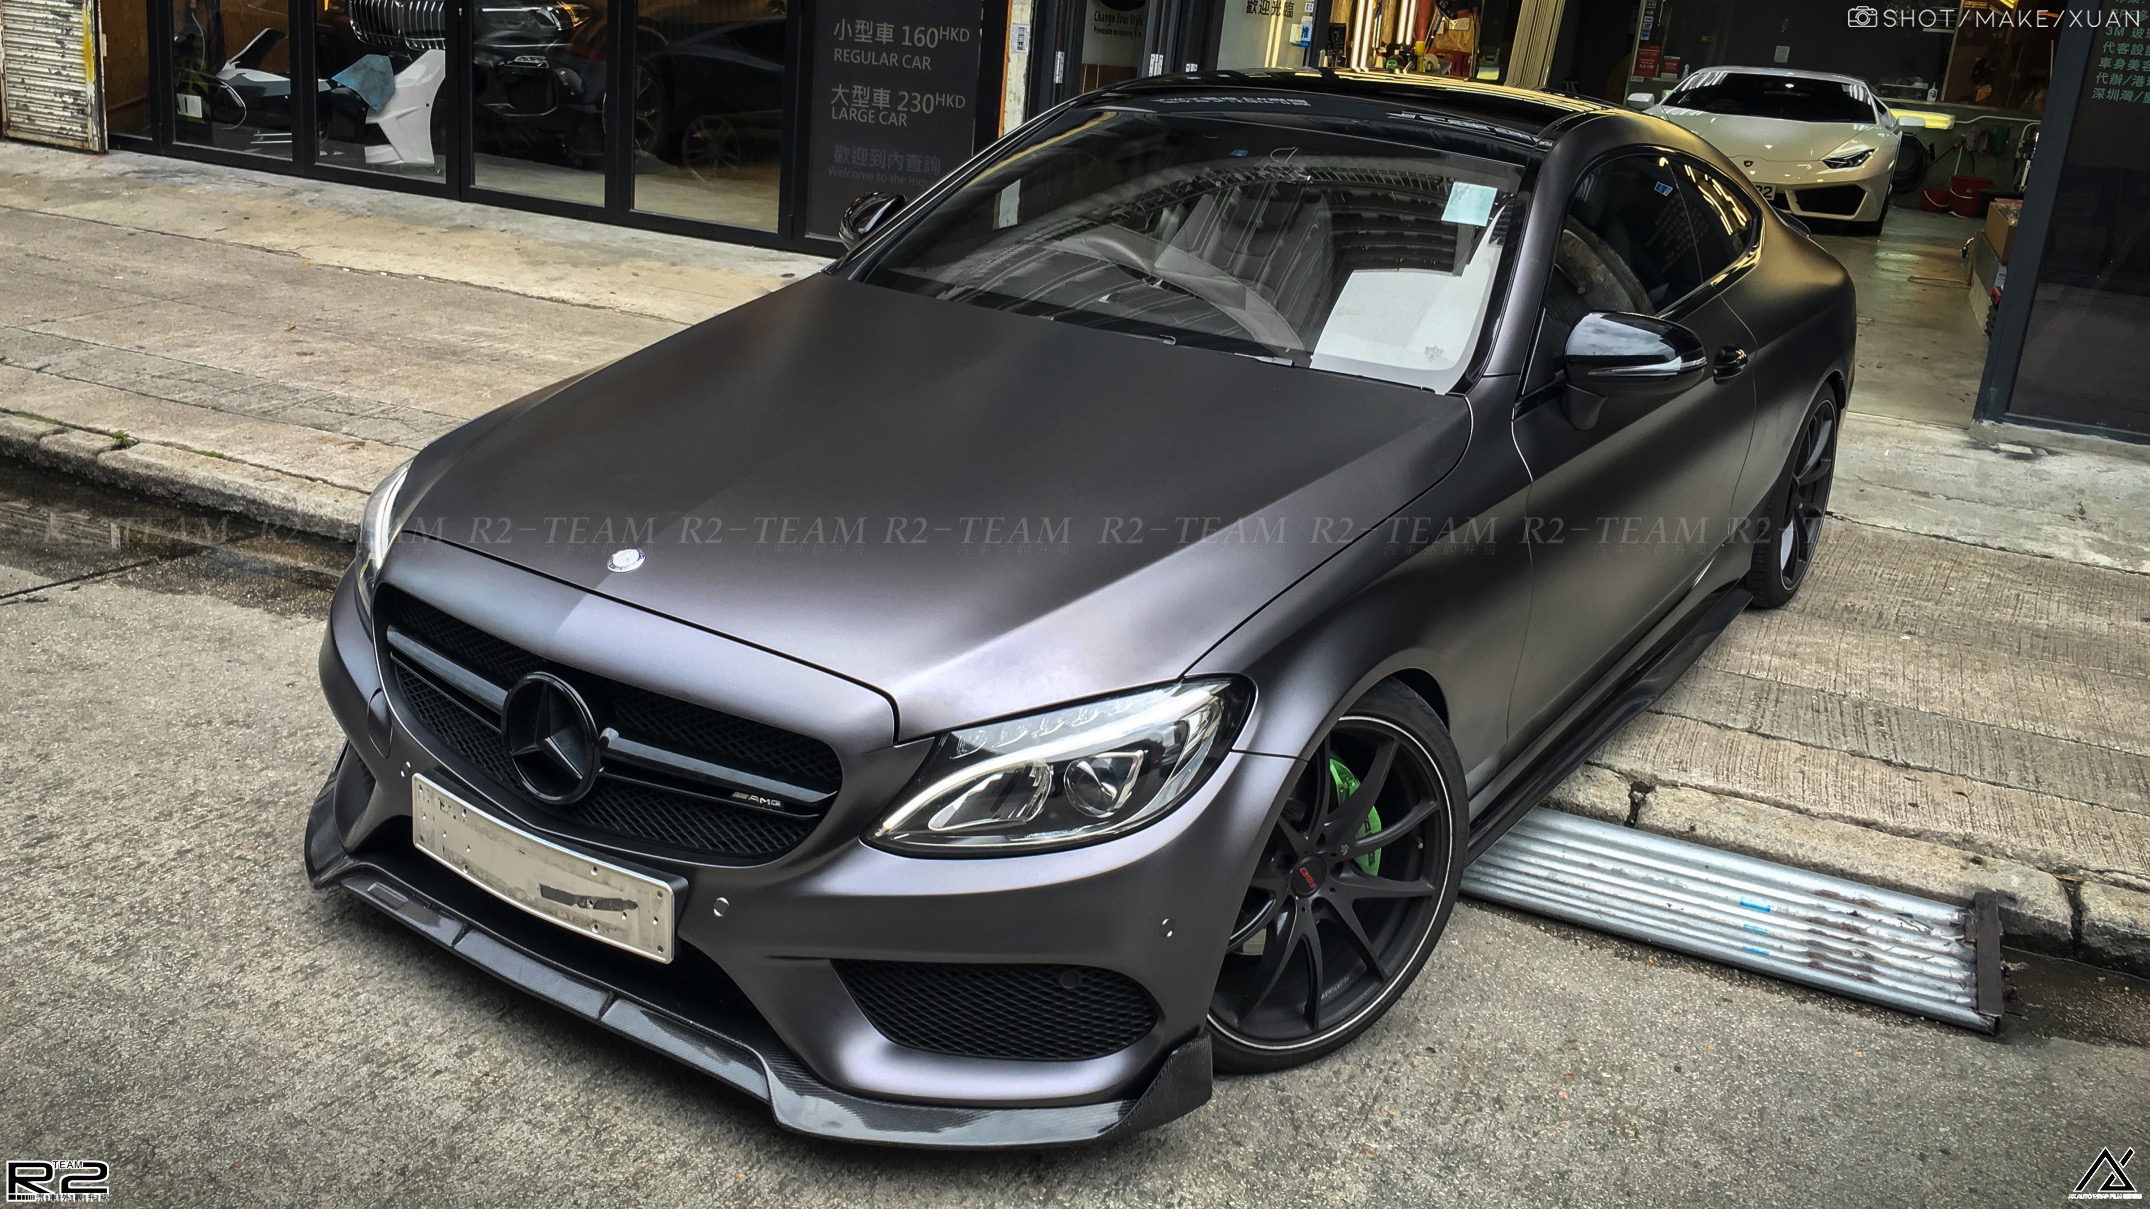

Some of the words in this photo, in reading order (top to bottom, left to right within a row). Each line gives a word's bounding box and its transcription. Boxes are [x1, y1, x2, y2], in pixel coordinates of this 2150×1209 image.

[1246, 0, 1295, 18] 歡迎光臨
[833, 18, 895, 45] 小型車
[2105, 26, 2125, 36] 3M
[834, 48, 899, 67] REGULAR
[902, 54, 932, 71] CAR
[830, 84, 891, 110] 大型車
[831, 107, 876, 124] LARGE
[879, 111, 908, 128] CAR
[833, 145, 942, 174] 歡迎到內查詢
[828, 166, 874, 182] Welcome
[877, 172, 888, 183] to
[890, 173, 907, 184] the
[748, 794, 781, 807] AMG
